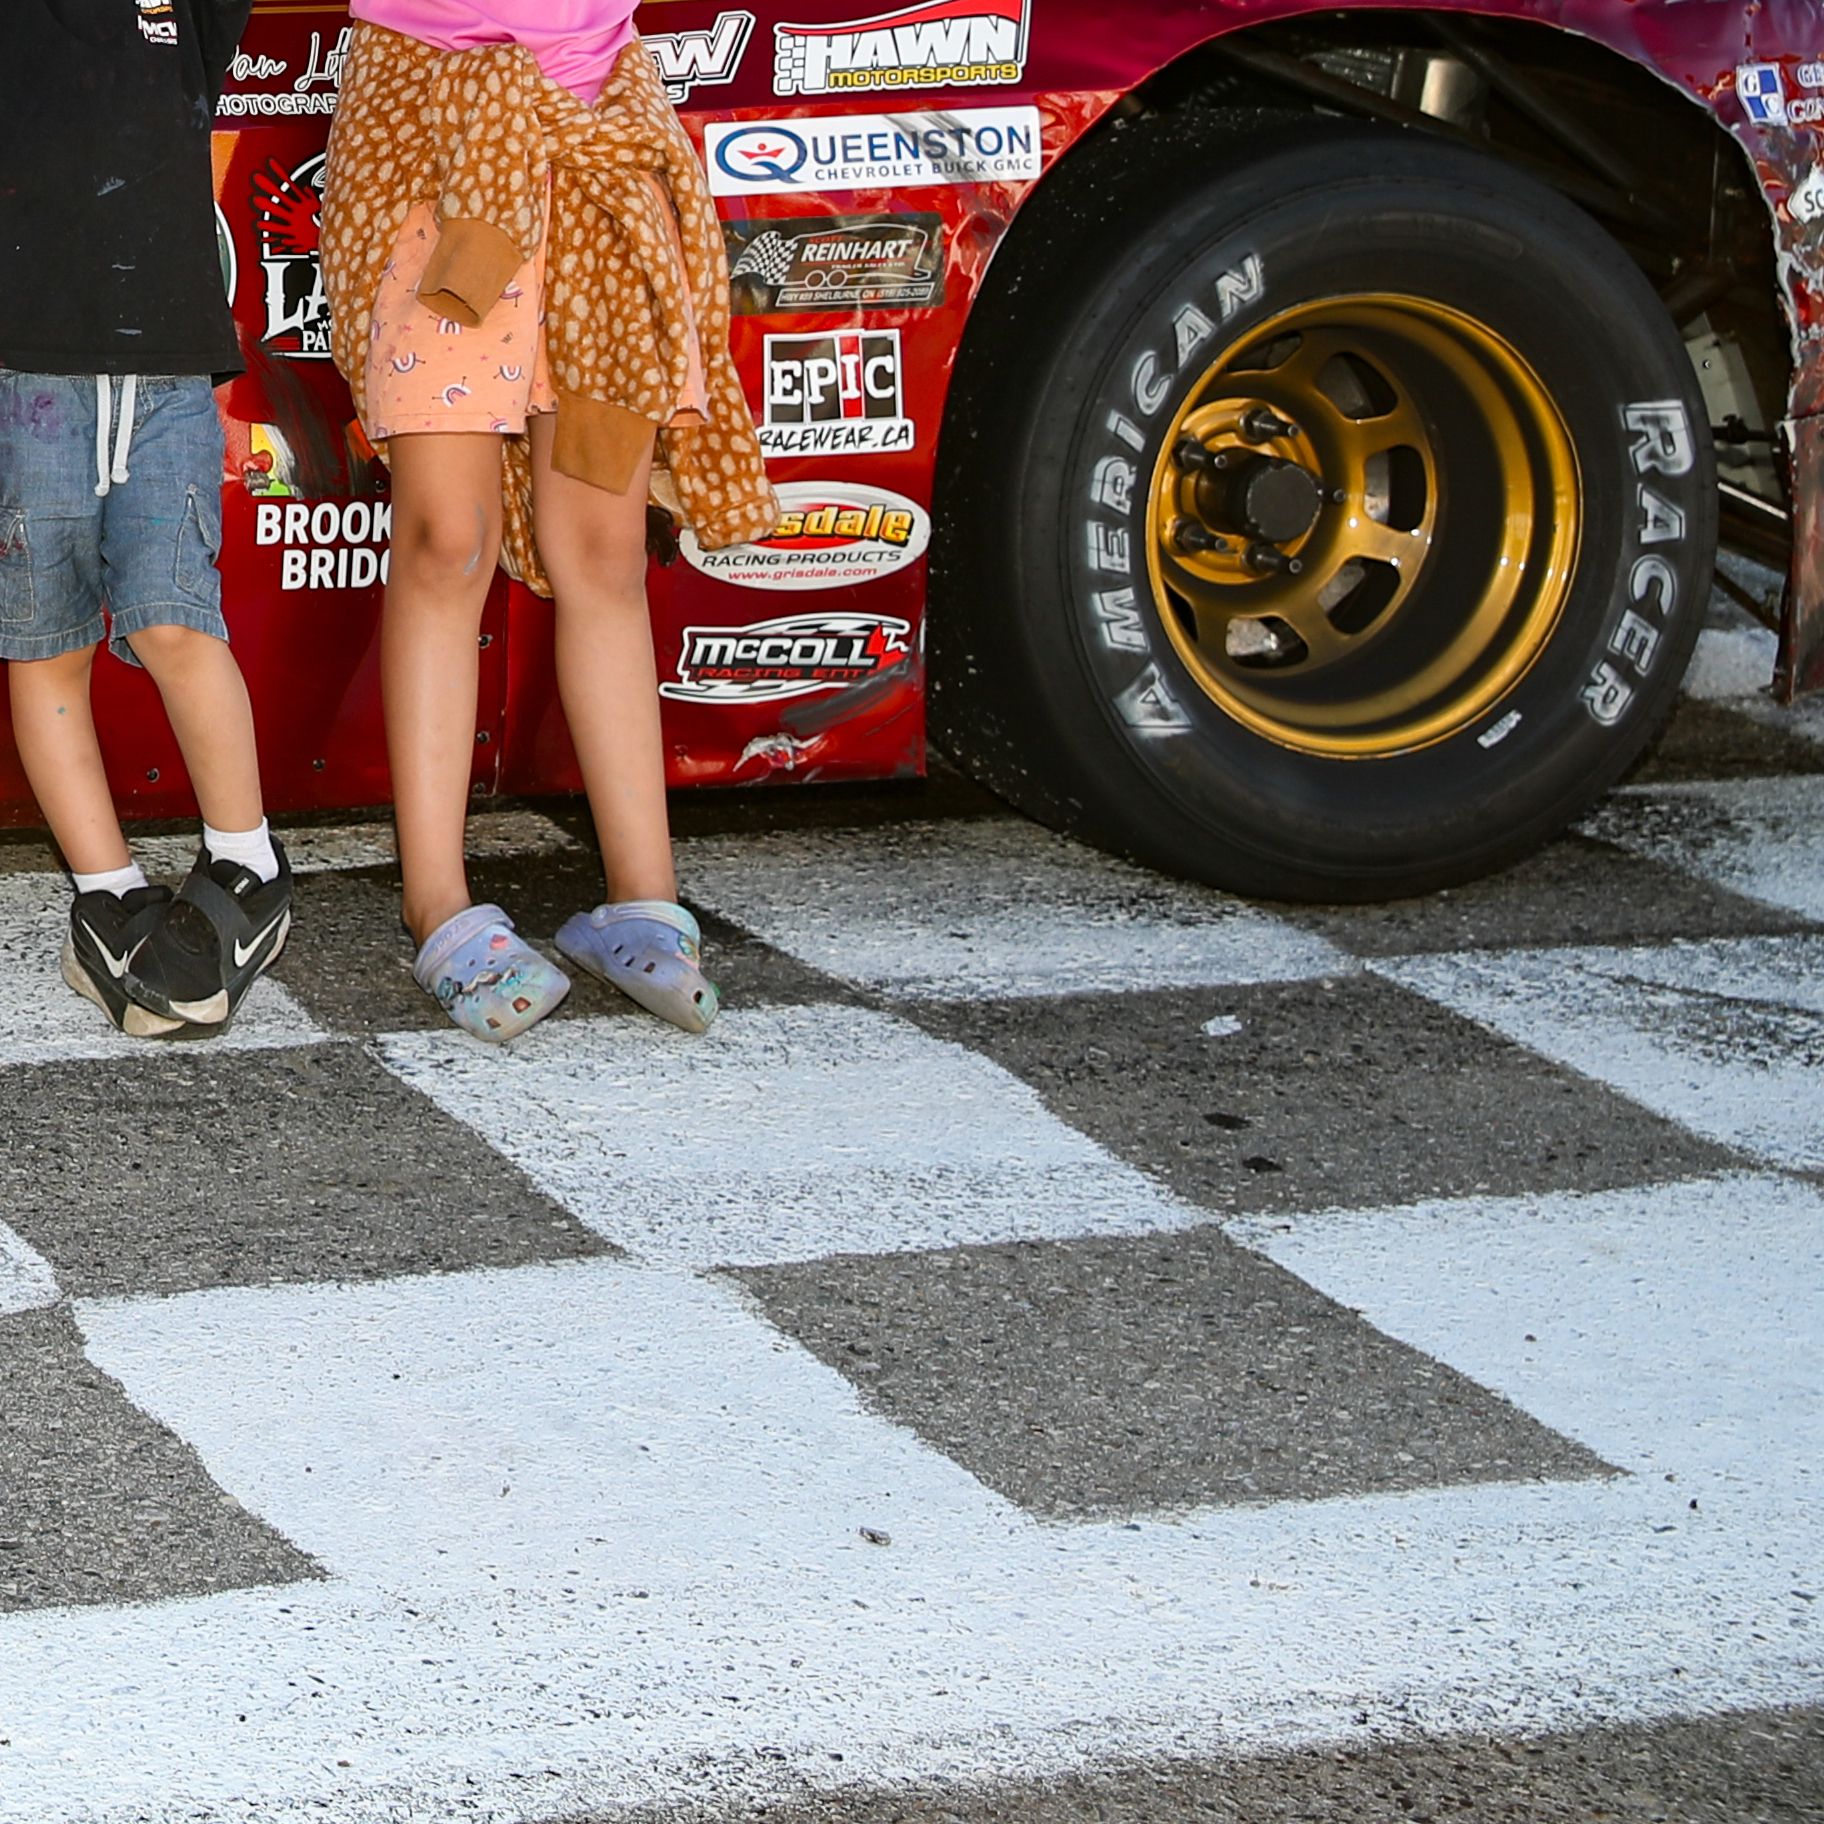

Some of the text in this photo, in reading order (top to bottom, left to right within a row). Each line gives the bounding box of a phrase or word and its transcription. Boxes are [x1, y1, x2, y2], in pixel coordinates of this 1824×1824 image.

[802, 14, 1020, 88] HAWN
[828, 62, 1019, 89] MOTORSPORTS
[815, 158, 1034, 181] CHEVROLET BUICK GMC
[801, 240, 913, 262] REINHART
[770, 354, 895, 405] EPIC
[1083, 251, 1265, 739] AMERICAN
[777, 504, 914, 546] sdale
[702, 550, 902, 568] RACING PRODUCTS
[728, 569, 878, 582] www.grisdale.com
[1576, 398, 1697, 728] RACER
